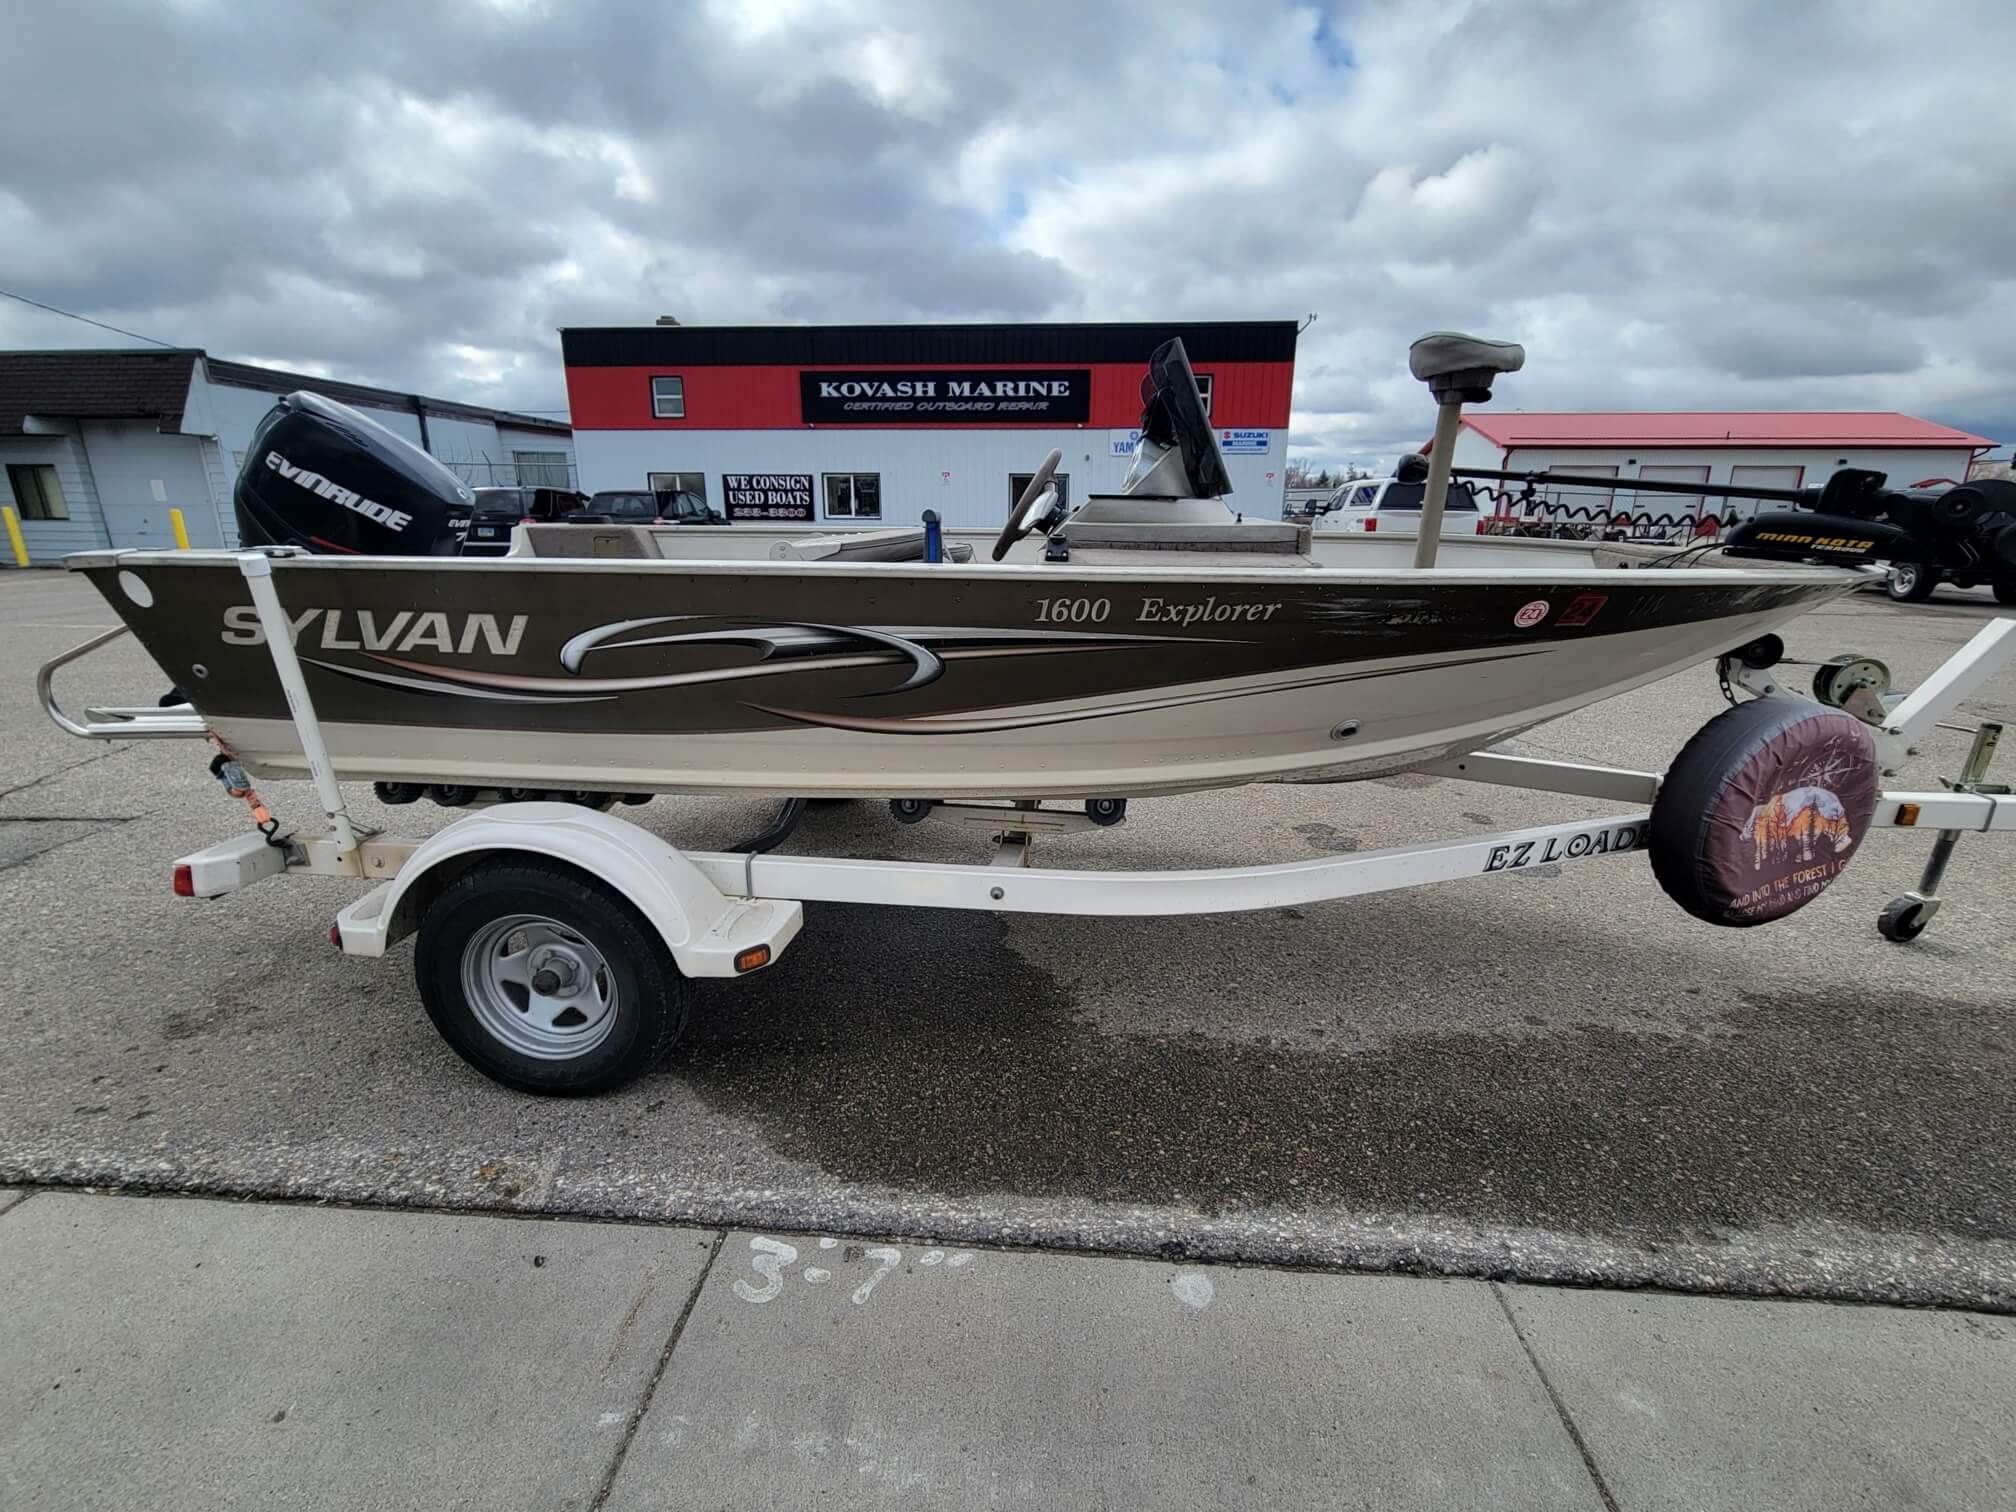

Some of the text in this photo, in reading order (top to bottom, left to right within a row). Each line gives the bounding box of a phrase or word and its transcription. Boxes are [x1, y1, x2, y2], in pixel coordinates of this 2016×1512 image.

[819, 381, 1071, 397] KOVASH MARINE
[843, 401, 1050, 411] CERTIFIED OUTBOARD REPAIR
[1233, 431, 1269, 439] SUZUKI
[1113, 441, 1135, 453] YAM
[265, 450, 413, 531] EVINRUDE
[726, 475, 809, 490] WE CONSIGN
[728, 491, 810, 504] USED BOATS
[1756, 532, 1875, 549] MINN KOTA
[1034, 596, 1283, 627] 1600 Explorer
[221, 605, 529, 656] SYLVAN
[1482, 823, 1651, 872] EZ LOADE
[1729, 893, 1750, 909] AND
[1752, 884, 1770, 901] INTO
[1774, 876, 1791, 892] THE
[1793, 864, 1828, 884] FOREST
